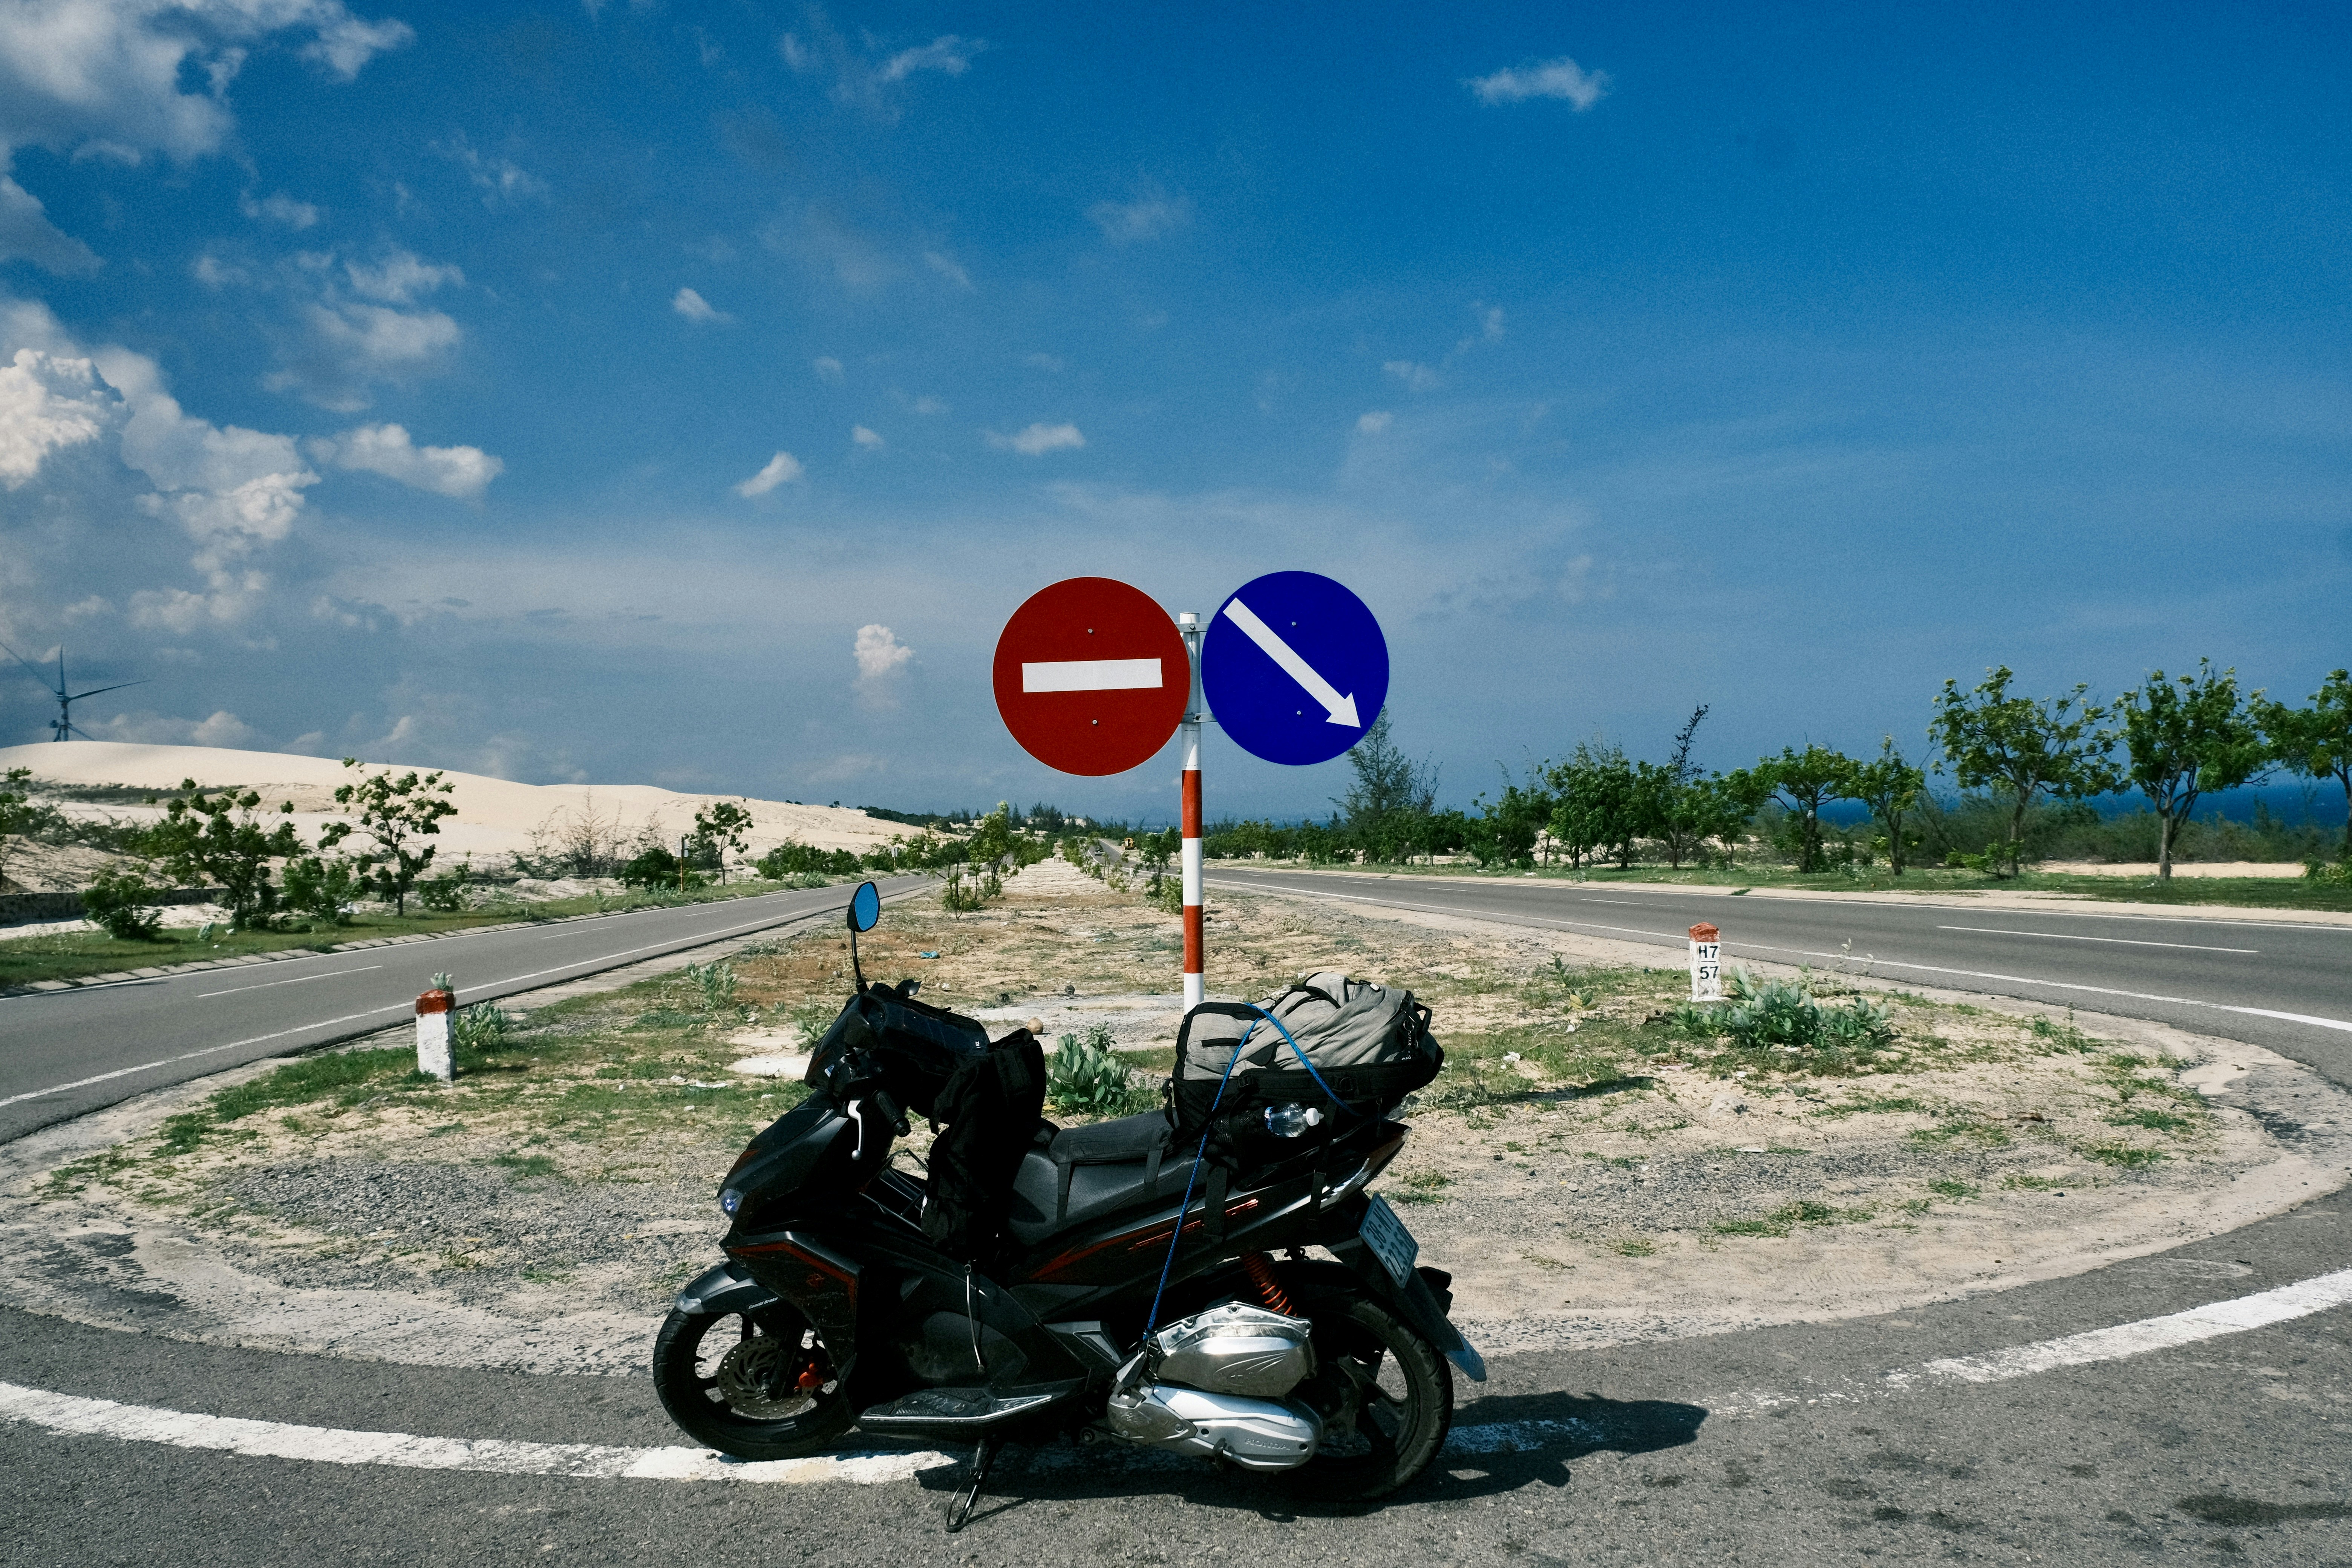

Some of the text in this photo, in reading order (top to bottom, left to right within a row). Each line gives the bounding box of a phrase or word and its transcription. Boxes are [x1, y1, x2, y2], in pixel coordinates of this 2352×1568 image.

[1698, 945, 1718, 959] H7
[1700, 966, 1719, 980] 57
[1244, 1438, 1291, 1450] HONDA
